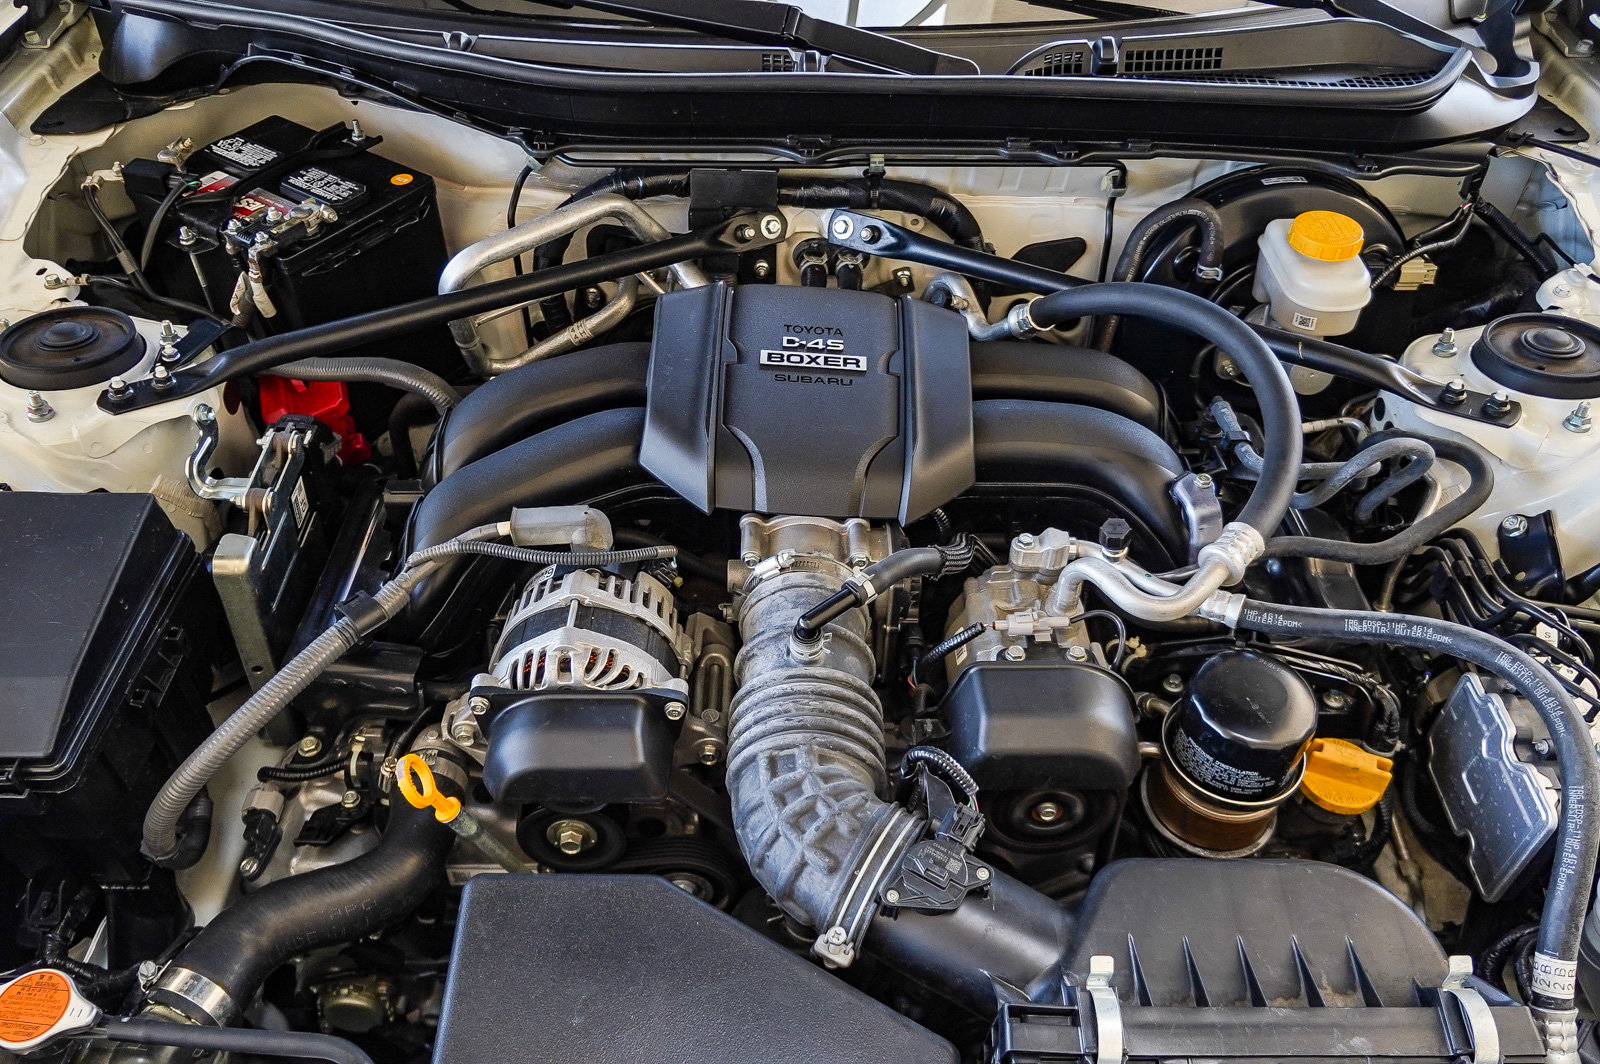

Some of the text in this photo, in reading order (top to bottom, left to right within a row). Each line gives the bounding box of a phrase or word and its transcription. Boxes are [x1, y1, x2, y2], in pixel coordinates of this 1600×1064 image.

[784, 324, 843, 336] TOYOTA
[782, 336, 844, 351] D-4S
[767, 352, 861, 368] BOXER
[774, 374, 853, 386] SUBARU
